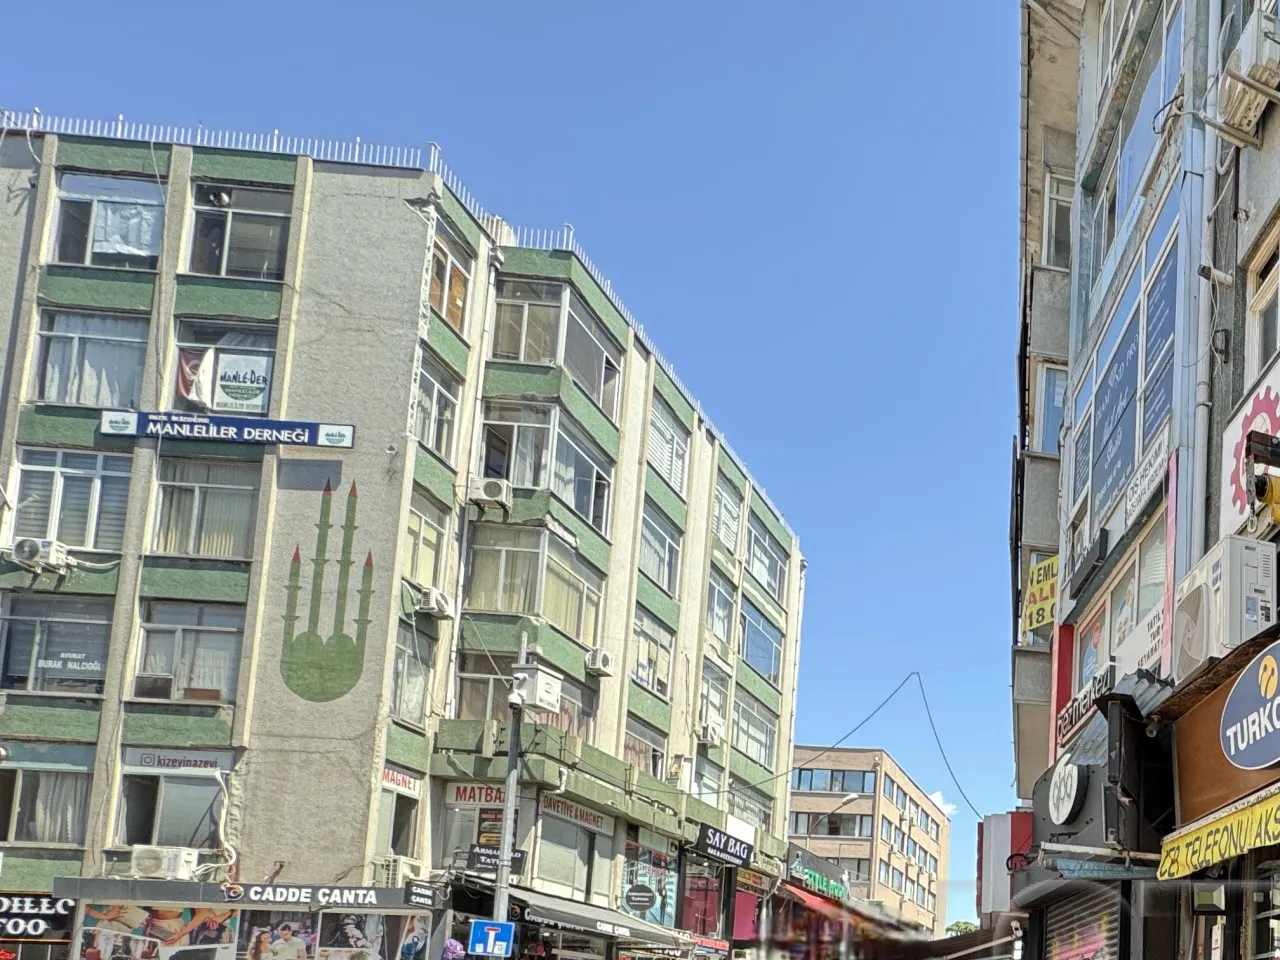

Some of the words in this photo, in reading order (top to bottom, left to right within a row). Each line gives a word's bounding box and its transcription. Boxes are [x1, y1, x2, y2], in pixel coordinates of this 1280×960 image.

[147, 421, 237, 440] MANLELİLER
[243, 426, 309, 444] DERNEĞİ
[383, 768, 417, 792] MAGNET
[579, 810, 604, 830] MAGNET
[705, 828, 726, 851] SAY
[727, 838, 748, 860] BAG
[1185, 816, 1250, 872] TELEFONU
[249, 885, 312, 903] CADDE
[317, 887, 378, 906] ÇANTA
[412, 886, 434, 896] CADDE
